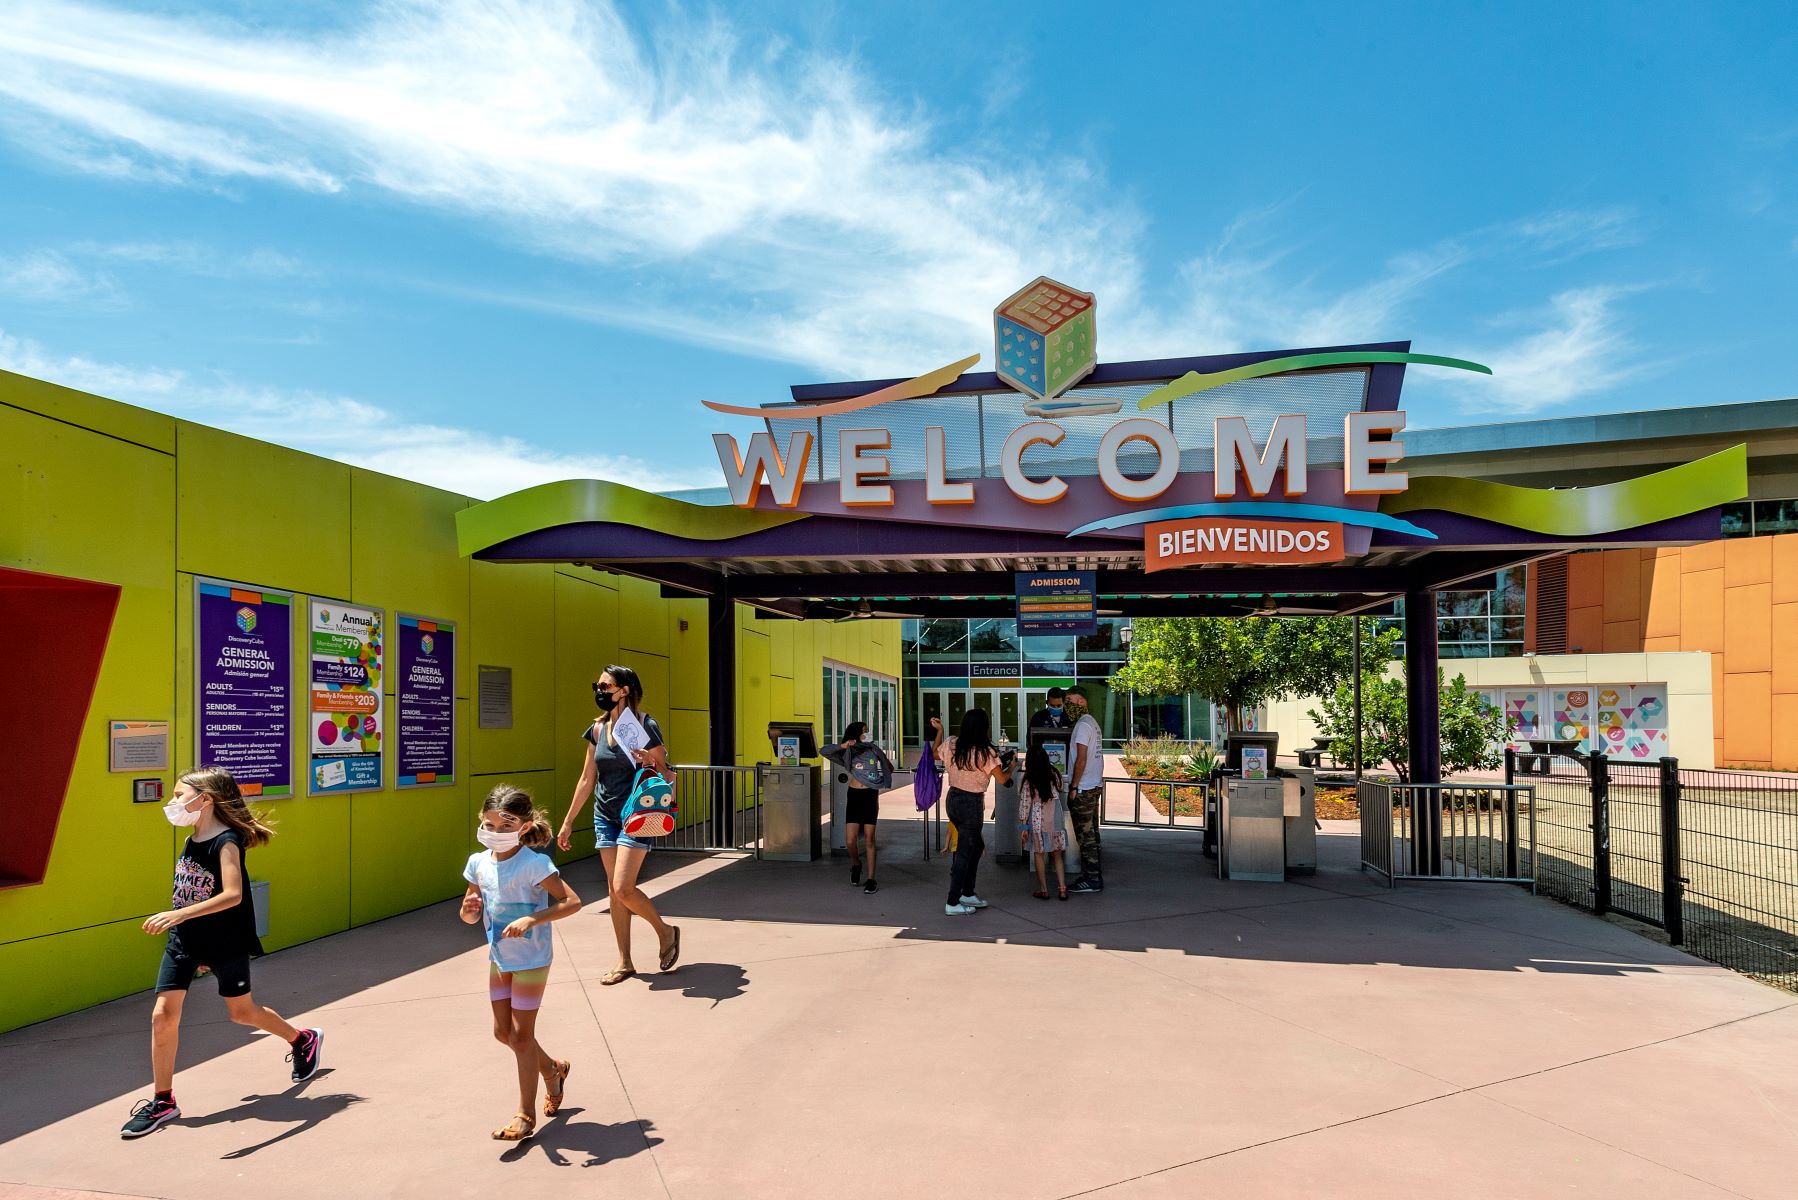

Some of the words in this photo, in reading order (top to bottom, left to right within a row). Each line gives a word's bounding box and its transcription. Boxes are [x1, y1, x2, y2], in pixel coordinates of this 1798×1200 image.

[712, 410, 1409, 508] WELCOME
[1158, 527, 1331, 558] BIENVENIDOS
[1030, 578, 1081, 587] ADMISSION
[342, 612, 373, 626] Annual
[336, 624, 369, 635] Membersh
[228, 635, 265, 645] DiscoveryCube
[343, 638, 360, 650] $79
[222, 646, 271, 660] GENERAL
[216, 657, 275, 671] ADMISSION
[327, 664, 343, 672] Family
[343, 666, 365, 678] $124
[411, 665, 442, 675] GENERAL
[973, 665, 1018, 675] Entrance
[408, 673, 444, 684] ADMISSION
[205, 682, 233, 690] ADULTS
[354, 695, 375, 706] $203
[205, 703, 237, 711] SENIORS
